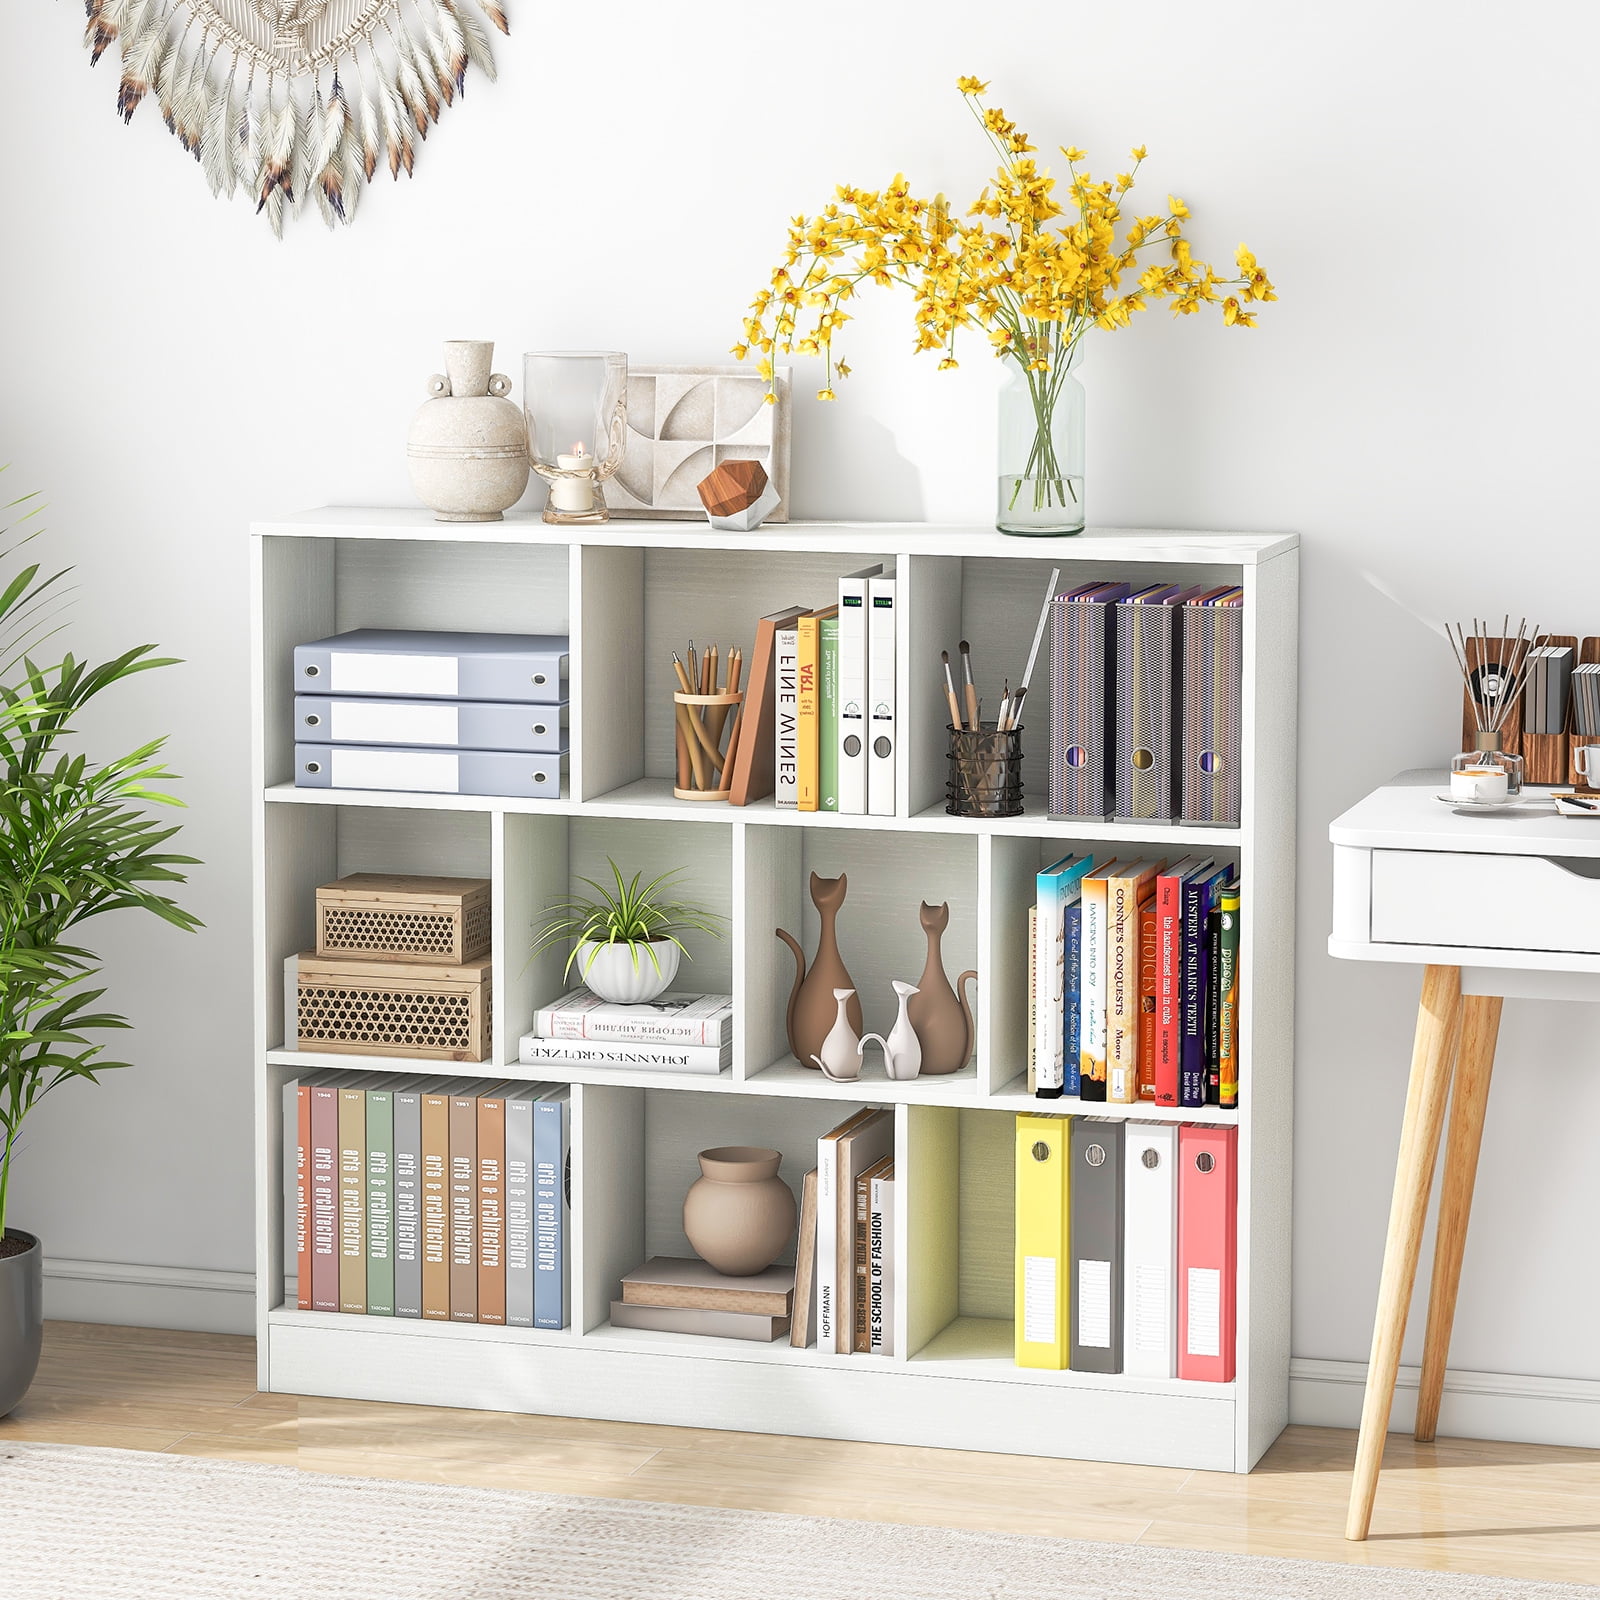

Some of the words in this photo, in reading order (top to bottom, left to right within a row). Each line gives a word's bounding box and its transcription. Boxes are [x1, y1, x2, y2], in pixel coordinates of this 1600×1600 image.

[1116, 888, 1124, 943] CONNIE'S
[1164, 917, 1172, 929] the
[1188, 891, 1198, 938] MYSTERY
[1142, 921, 1156, 991] CHOICES
[1164, 931, 1172, 976] handsomest
[1188, 942, 1198, 955] AT
[1114, 946, 1124, 1016] CONQUESTS
[1188, 957, 1197, 1000] SHARK'S
[594, 1024, 637, 1033] АНГЛИИ
[641, 1026, 691, 1036] ИСТОРИЯ
[1187, 1002, 1197, 1036] TEETH
[530, 1047, 604, 1061] GRÜTZKE
[607, 1052, 689, 1065] JOHANNES
[316, 1148, 334, 1169] arts
[343, 1150, 362, 1171] arts
[371, 1152, 390, 1173] arts
[399, 1154, 417, 1175] arts
[427, 1156, 445, 1177] arts
[455, 1158, 473, 1179] arts
[482, 1159, 501, 1181] arts
[510, 1161, 528, 1183] arts
[538, 1163, 556, 1185] arts
[857, 1194, 867, 1220] ROWLING
[316, 1188, 336, 1254] architecture
[344, 1190, 363, 1256] architecture
[371, 1192, 391, 1258] architecture
[399, 1193, 419, 1260] architecture
[427, 1195, 447, 1262] architecture
[455, 1197, 474, 1264] architecture
[483, 1199, 502, 1266] architecture
[510, 1201, 530, 1268] architecture
[538, 1203, 558, 1270] architecture
[872, 1212, 881, 1259] FASHION
[857, 1243, 866, 1264] POTTER
[872, 1262, 881, 1276] OF
[872, 1280, 881, 1324] SCHOOL
[856, 1309, 866, 1333] SECRETS
[872, 1326, 881, 1347] THE
